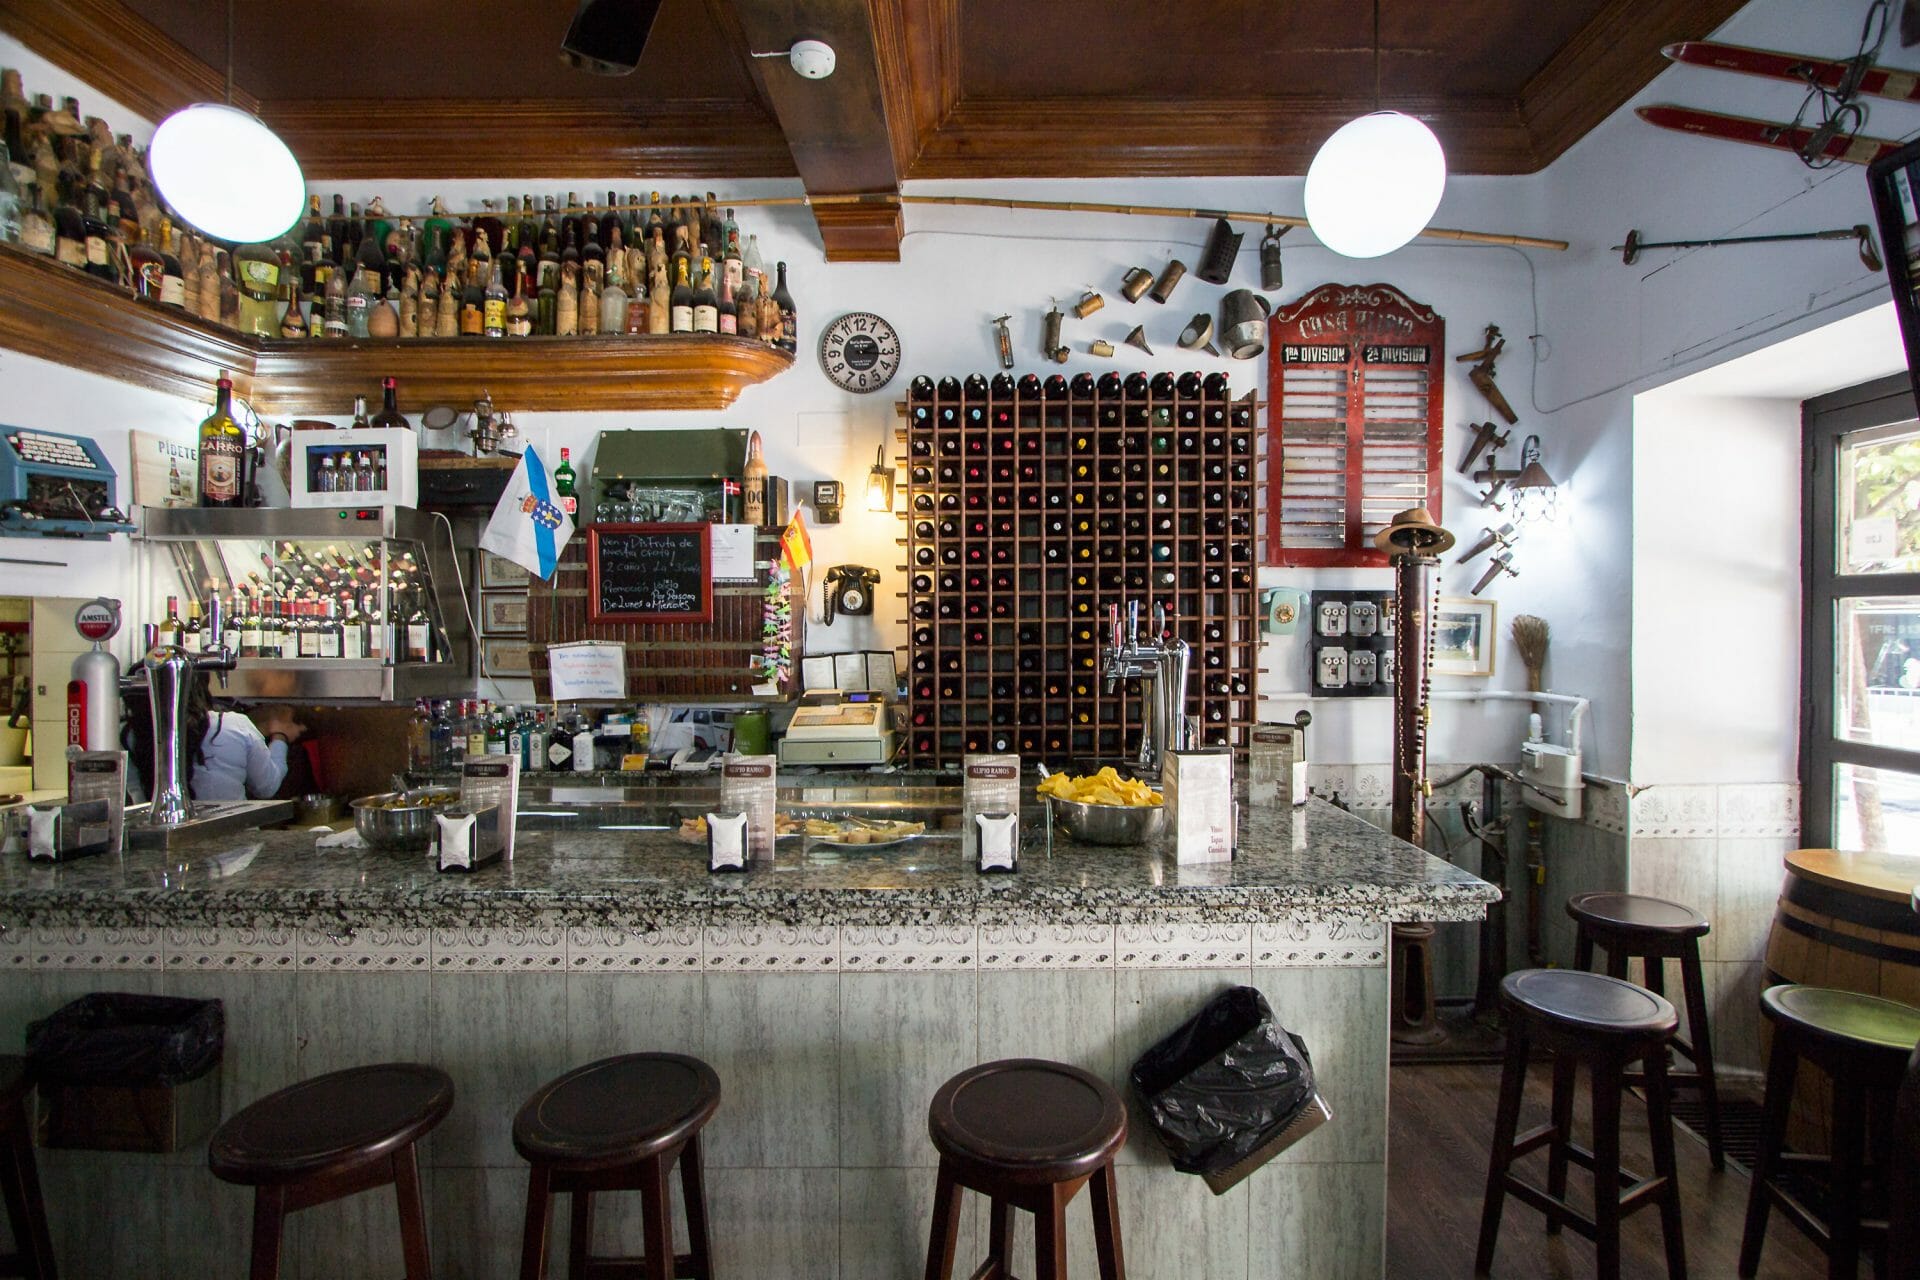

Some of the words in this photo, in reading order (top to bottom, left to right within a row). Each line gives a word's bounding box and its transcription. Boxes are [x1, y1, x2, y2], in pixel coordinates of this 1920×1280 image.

[841, 321, 853, 336] 11
[853, 318, 867, 332] 12
[869, 321, 878, 334] 1
[830, 334, 844, 346] 10
[877, 331, 890, 344] 2
[828, 350, 841, 358] 9
[881, 347, 895, 356] 3
[1301, 347, 1345, 362] DIVISION
[1381, 347, 1426, 362] DIVISION
[832, 362, 845, 373] 8
[880, 360, 892, 371] 4
[845, 371, 856, 384] 7
[858, 373, 867, 387] 6
[870, 369, 881, 381] 5
[200, 440, 243, 454] ZARRO
[679, 538, 694, 548] de
[991, 767, 1010, 775] RAMOS
